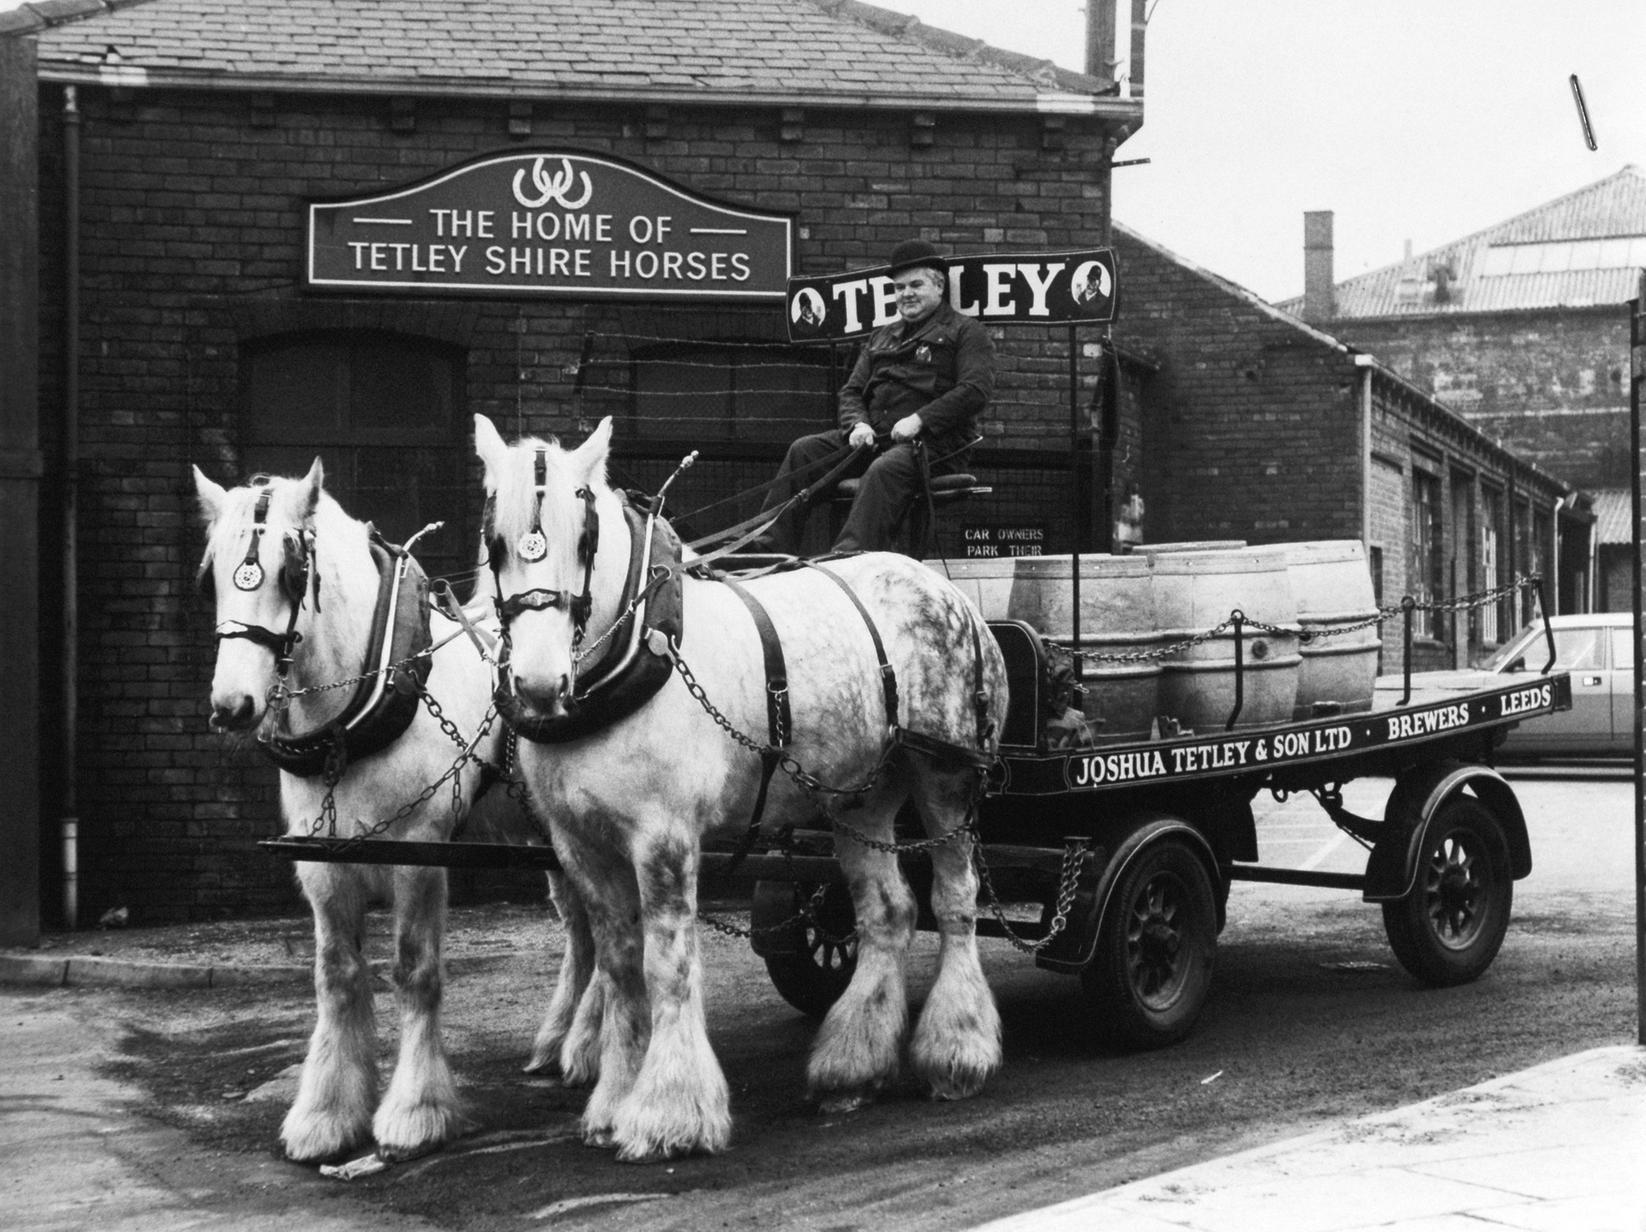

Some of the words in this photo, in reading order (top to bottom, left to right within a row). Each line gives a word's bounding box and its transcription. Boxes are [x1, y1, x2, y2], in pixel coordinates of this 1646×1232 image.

[430, 208, 495, 238] THE
[511, 211, 613, 242] HOME
[629, 215, 672, 244] OF
[348, 242, 468, 272] TETLEY
[485, 245, 592, 276] SHIRE
[609, 250, 752, 281] HORSES
[832, 262, 1066, 334] TELEY
[965, 528, 990, 541] CAR
[997, 528, 1044, 541] OWNERS
[967, 545, 999, 557] PARK
[1009, 544, 1042, 557] THEIR
[1076, 751, 1167, 785] JOSHUA
[1171, 741, 1251, 772] TETLEY
[1255, 738, 1268, 760] &
[1273, 731, 1310, 758] SON
[1314, 726, 1352, 752] LTD
[1387, 702, 1470, 740] BREWERS
[1500, 684, 1552, 716] LEEDS
